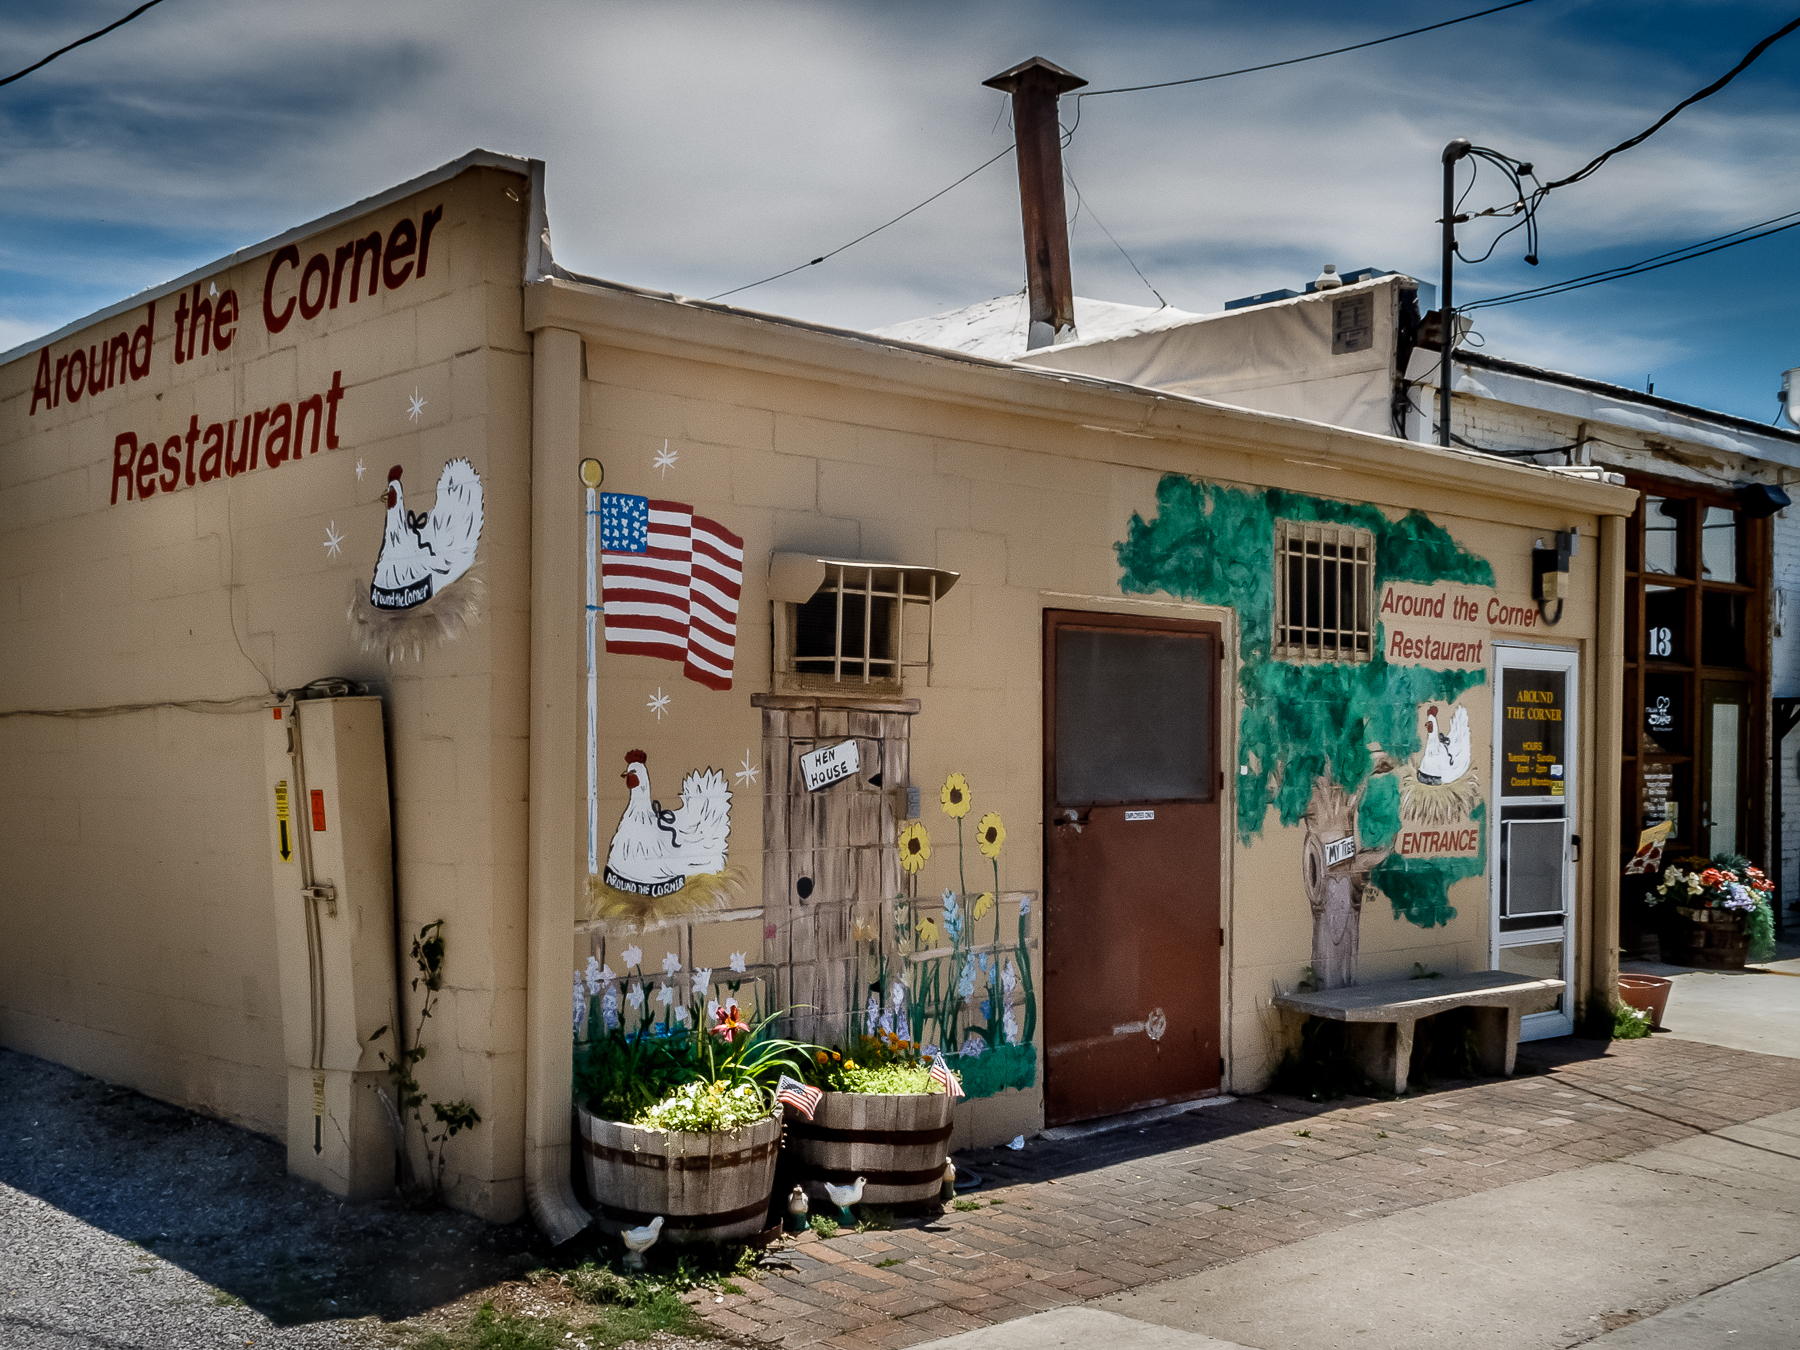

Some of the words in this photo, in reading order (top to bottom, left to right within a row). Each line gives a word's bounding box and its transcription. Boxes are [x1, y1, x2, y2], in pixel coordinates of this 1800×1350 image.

[29, 301, 156, 416] Around
[174, 284, 239, 365] the
[263, 204, 443, 334] Corner
[110, 370, 345, 505] Restaurant
[371, 588, 395, 606] Around
[404, 584, 429, 606] Corner
[1381, 587, 1446, 619] Around
[1453, 595, 1479, 622] the
[1487, 597, 1541, 628] Corner
[1390, 630, 1483, 664] Restaurant
[1649, 626, 1672, 656] 13
[1517, 690, 1553, 704] AROUND
[1507, 706, 1525, 720] THE
[1527, 707, 1562, 721] CORNER
[1522, 741, 1542, 751] HOURS
[815, 749, 835, 767] HEN
[811, 761, 848, 786] HOUSE
[1329, 844, 1340, 862] MY
[1402, 829, 1478, 855] ENTRANCE
[606, 872, 637, 893] AROUND
[638, 884, 650, 894] THE
